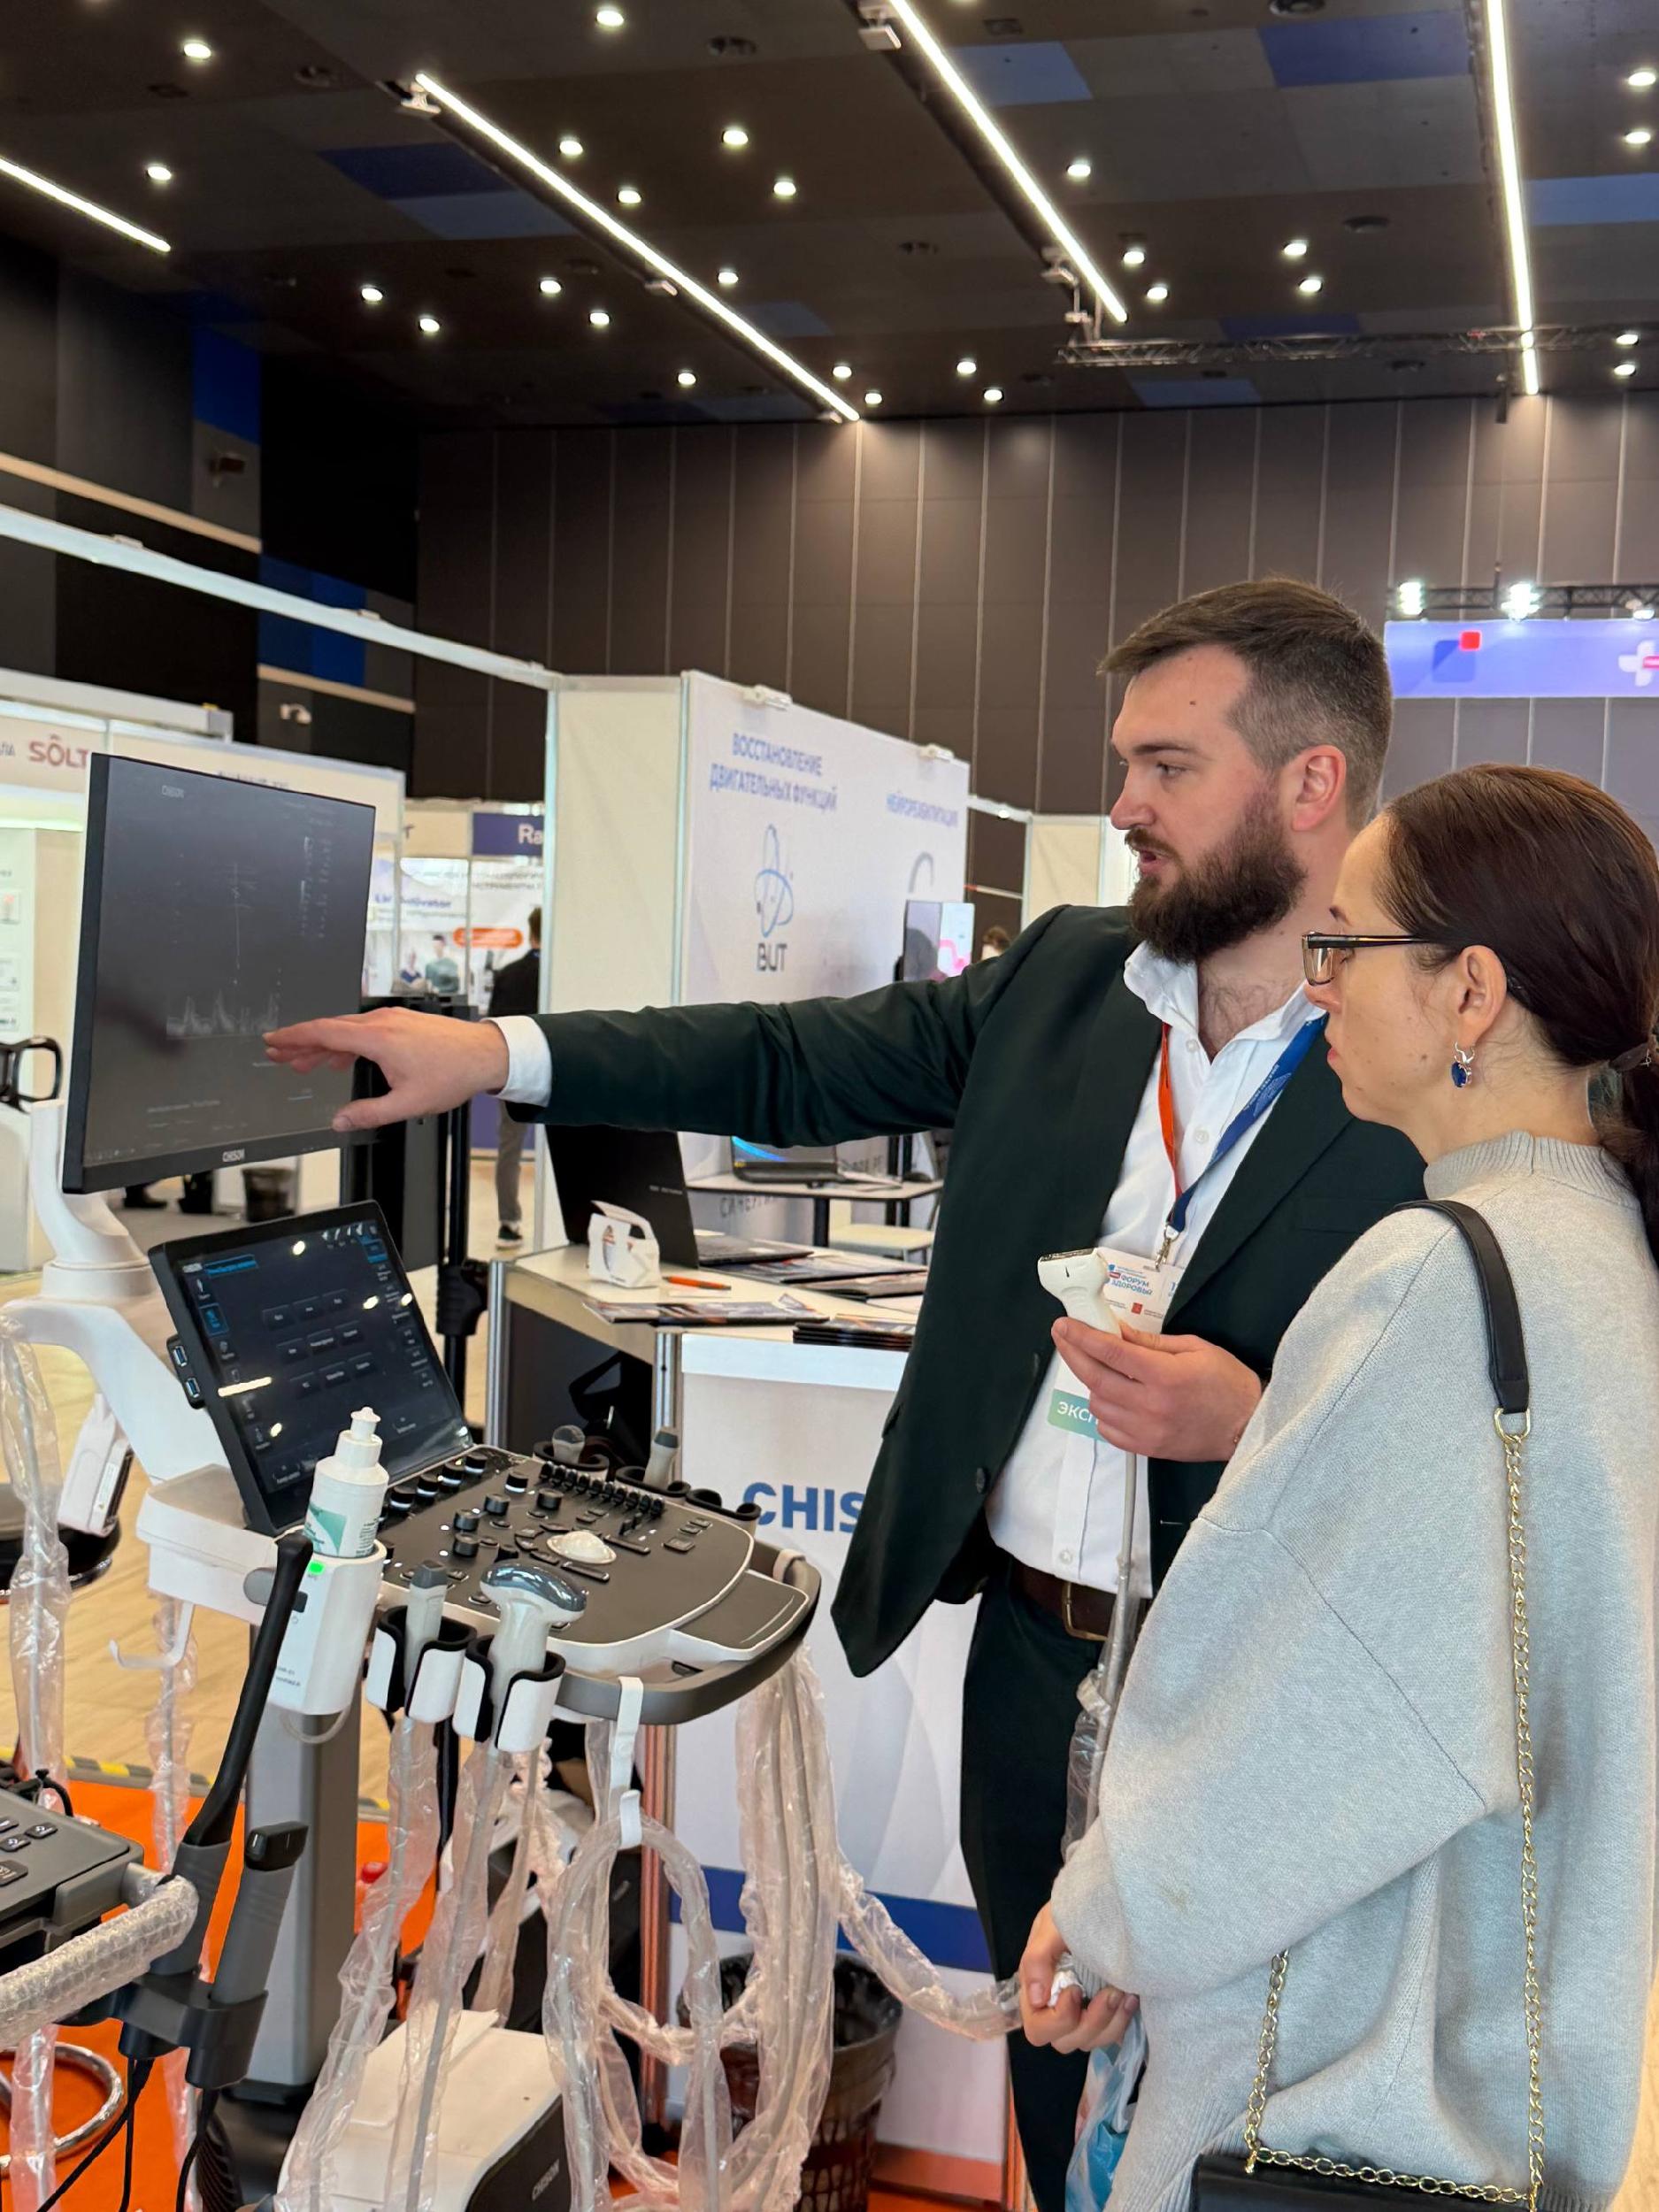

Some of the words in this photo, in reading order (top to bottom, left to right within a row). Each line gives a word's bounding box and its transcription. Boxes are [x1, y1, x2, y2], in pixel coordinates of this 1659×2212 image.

[733, 733, 822, 777] ВОССТАНОВЛЕНИЕ
[710, 763, 792, 802] ДВИГАТЕЛЬНЫХ
[1111, 1279, 1154, 1295] ЗДОРОВЬЯ
[1121, 1275, 1149, 1287] ФОРУМ
[742, 1481, 865, 1534] CHIS
